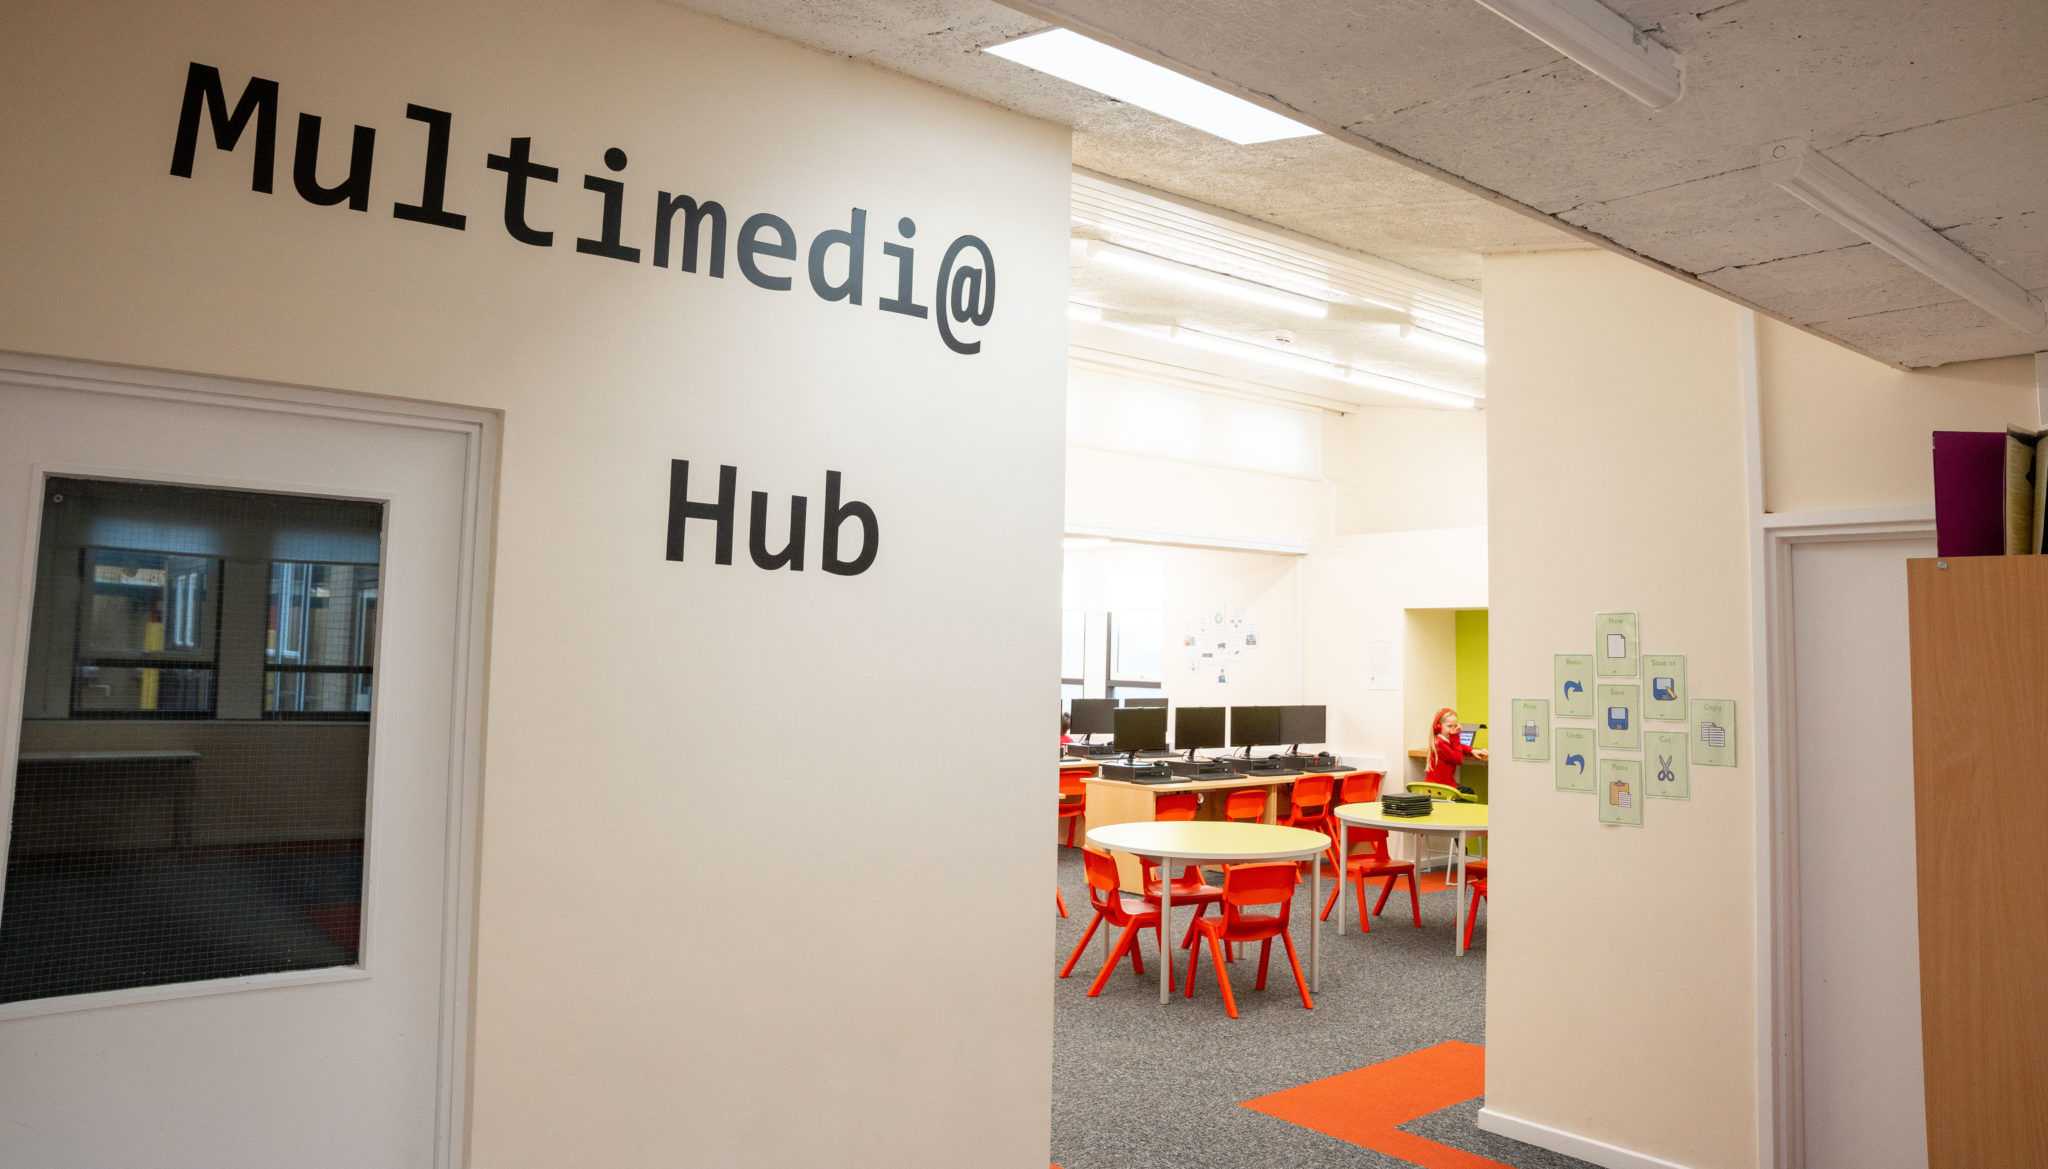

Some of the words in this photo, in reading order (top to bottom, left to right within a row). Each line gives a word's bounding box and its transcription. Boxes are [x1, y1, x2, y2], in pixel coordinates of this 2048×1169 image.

[170, 61, 996, 355] Multimedi@
[665, 459, 879, 576] Hub
[1608, 617, 1623, 625] New
[1651, 659, 1666, 667] Save
[1610, 688, 1625, 696] Save
[1703, 704, 1722, 713] Copy
[1566, 732, 1583, 740] Undo
[1659, 735, 1672, 743] Cut
[1612, 763, 1629, 771] Paste
